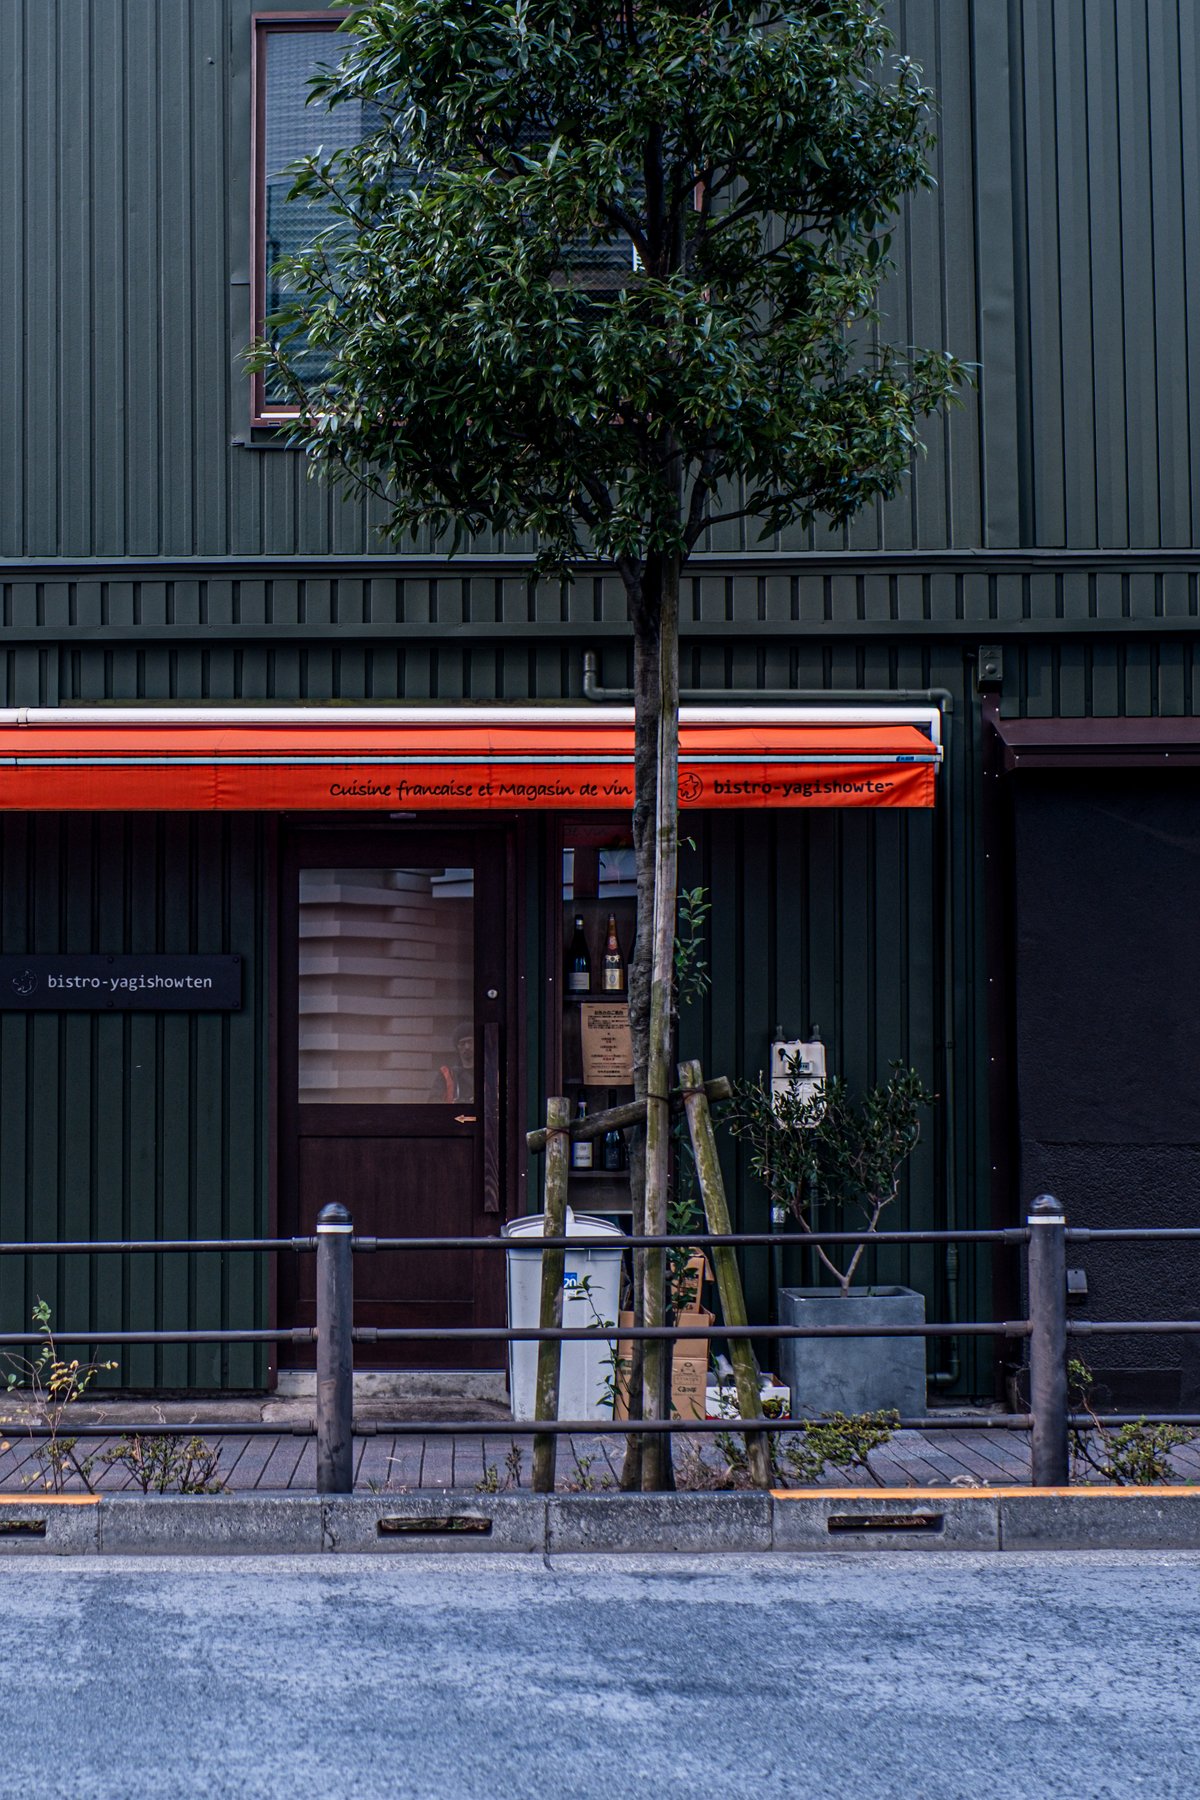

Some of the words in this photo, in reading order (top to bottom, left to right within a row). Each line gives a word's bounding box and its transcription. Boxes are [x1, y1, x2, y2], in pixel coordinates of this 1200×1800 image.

[330, 780, 391, 796] Cuisine
[396, 780, 472, 800] francaise
[478, 784, 494, 796] et
[499, 780, 574, 800] Magasin
[579, 783, 598, 796] de
[603, 780, 633, 795] vin
[48, 975, 212, 991] bistro-yagishowten
